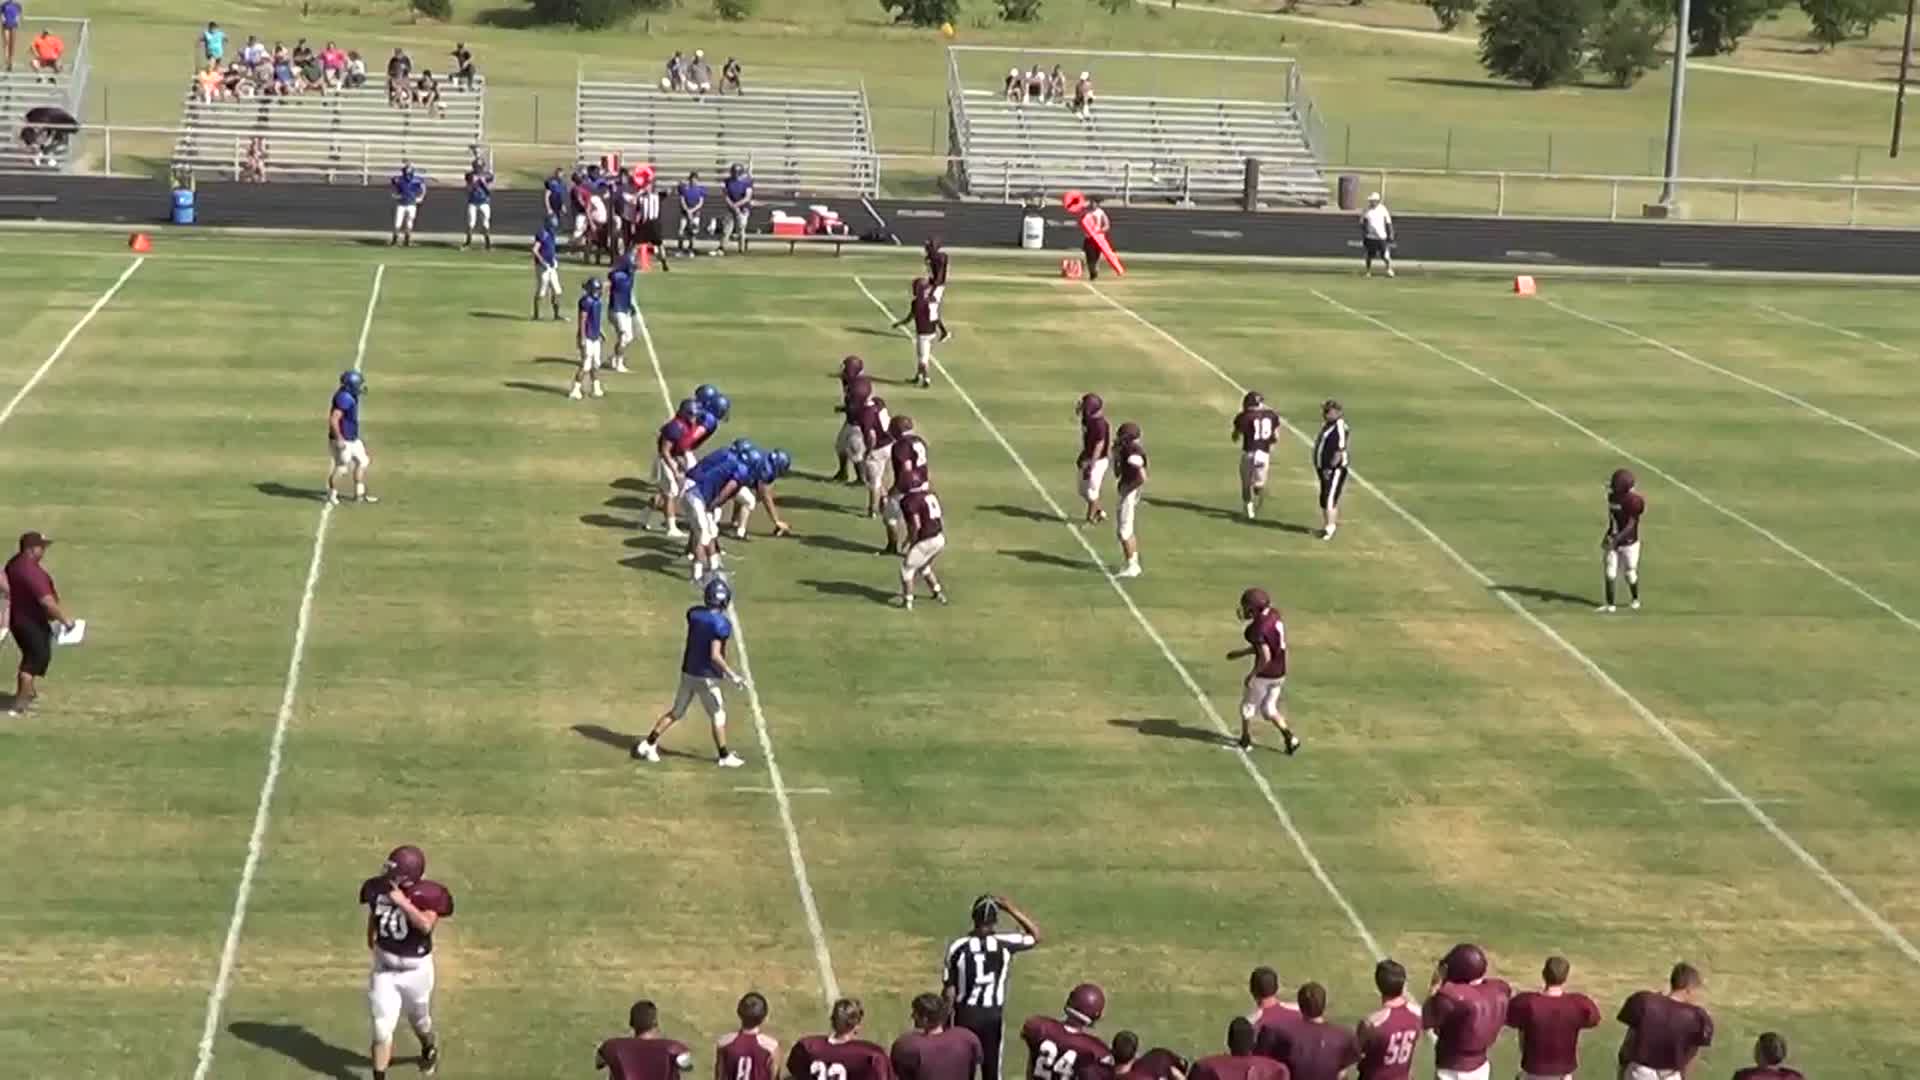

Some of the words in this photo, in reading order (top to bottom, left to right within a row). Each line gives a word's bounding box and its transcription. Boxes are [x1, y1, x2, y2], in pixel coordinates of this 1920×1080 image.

[376, 903, 408, 940] 70
[974, 953, 995, 984] L
[1034, 1039, 1077, 1080] 24
[1384, 1031, 1416, 1065] 56
